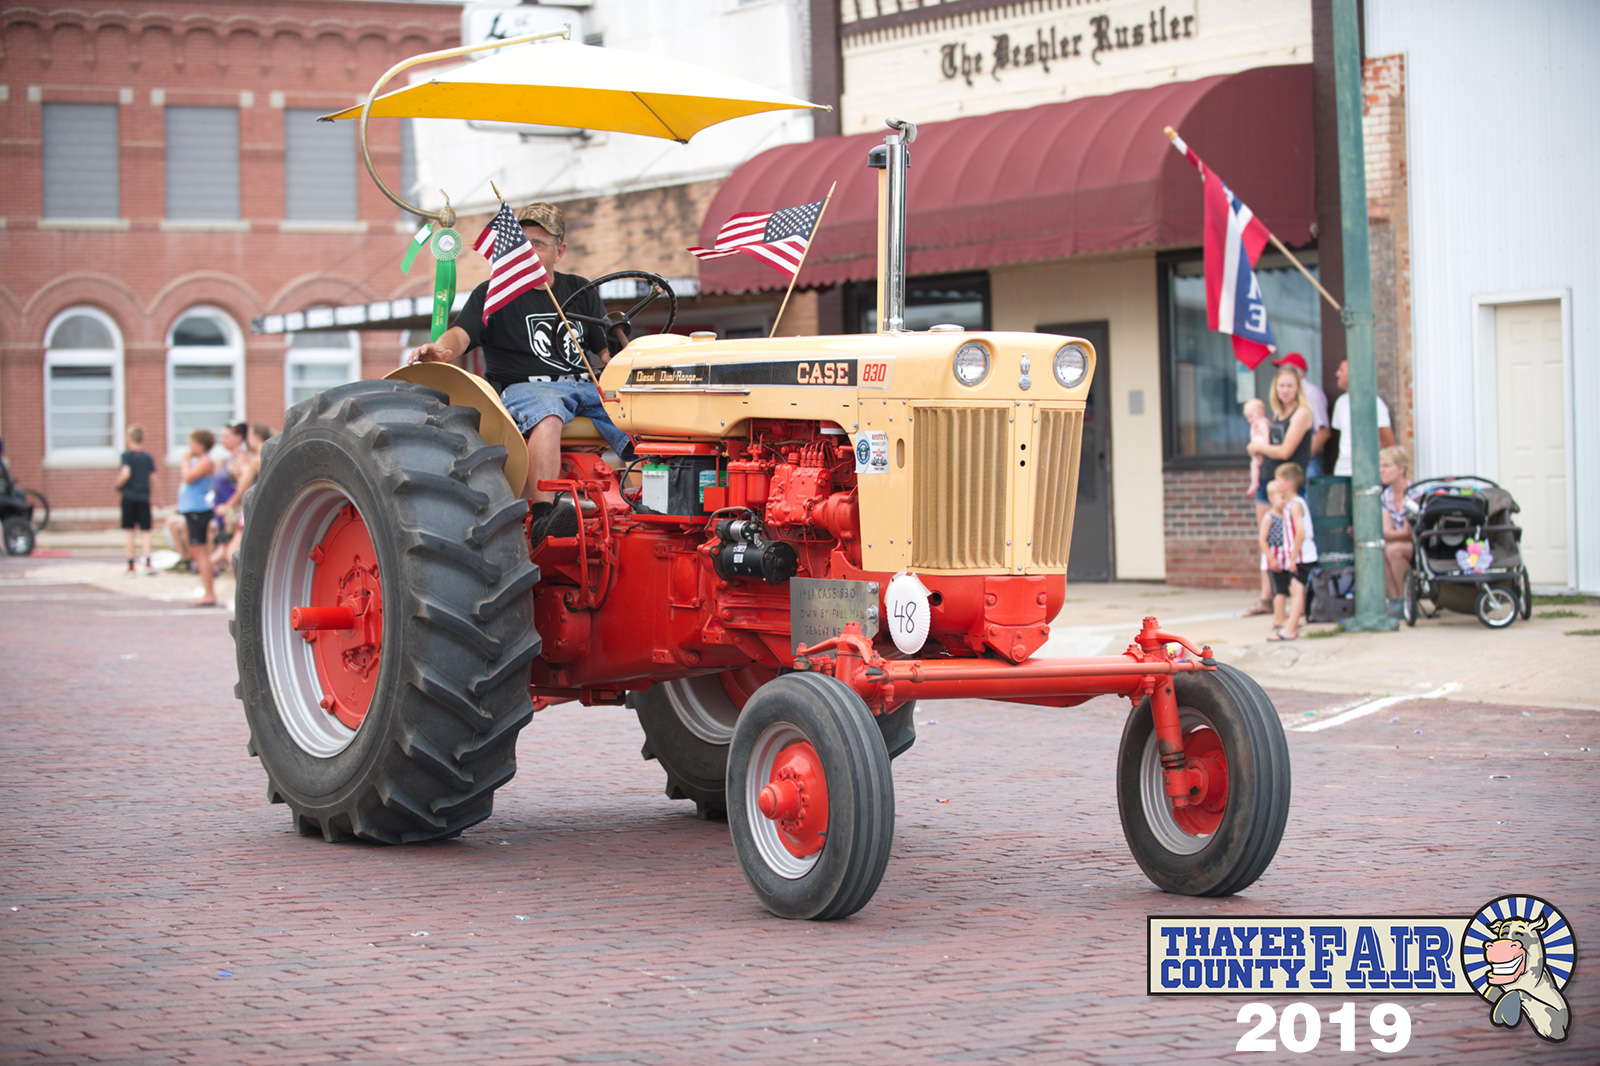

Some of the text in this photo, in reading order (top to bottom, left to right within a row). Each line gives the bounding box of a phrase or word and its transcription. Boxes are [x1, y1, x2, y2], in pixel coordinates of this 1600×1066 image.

[940, 5, 1195, 86] The Deshler Rustler
[636, 370, 656, 382] Diesel
[797, 362, 849, 385] CASE
[862, 363, 887, 382] 830
[817, 587, 837, 599] CASE
[840, 588, 856, 599] 830
[800, 609, 818, 619] OWN
[820, 608, 829, 619] BY
[832, 608, 848, 619] PAUL
[894, 600, 917, 634] 48
[804, 625, 829, 636] GENEVA
